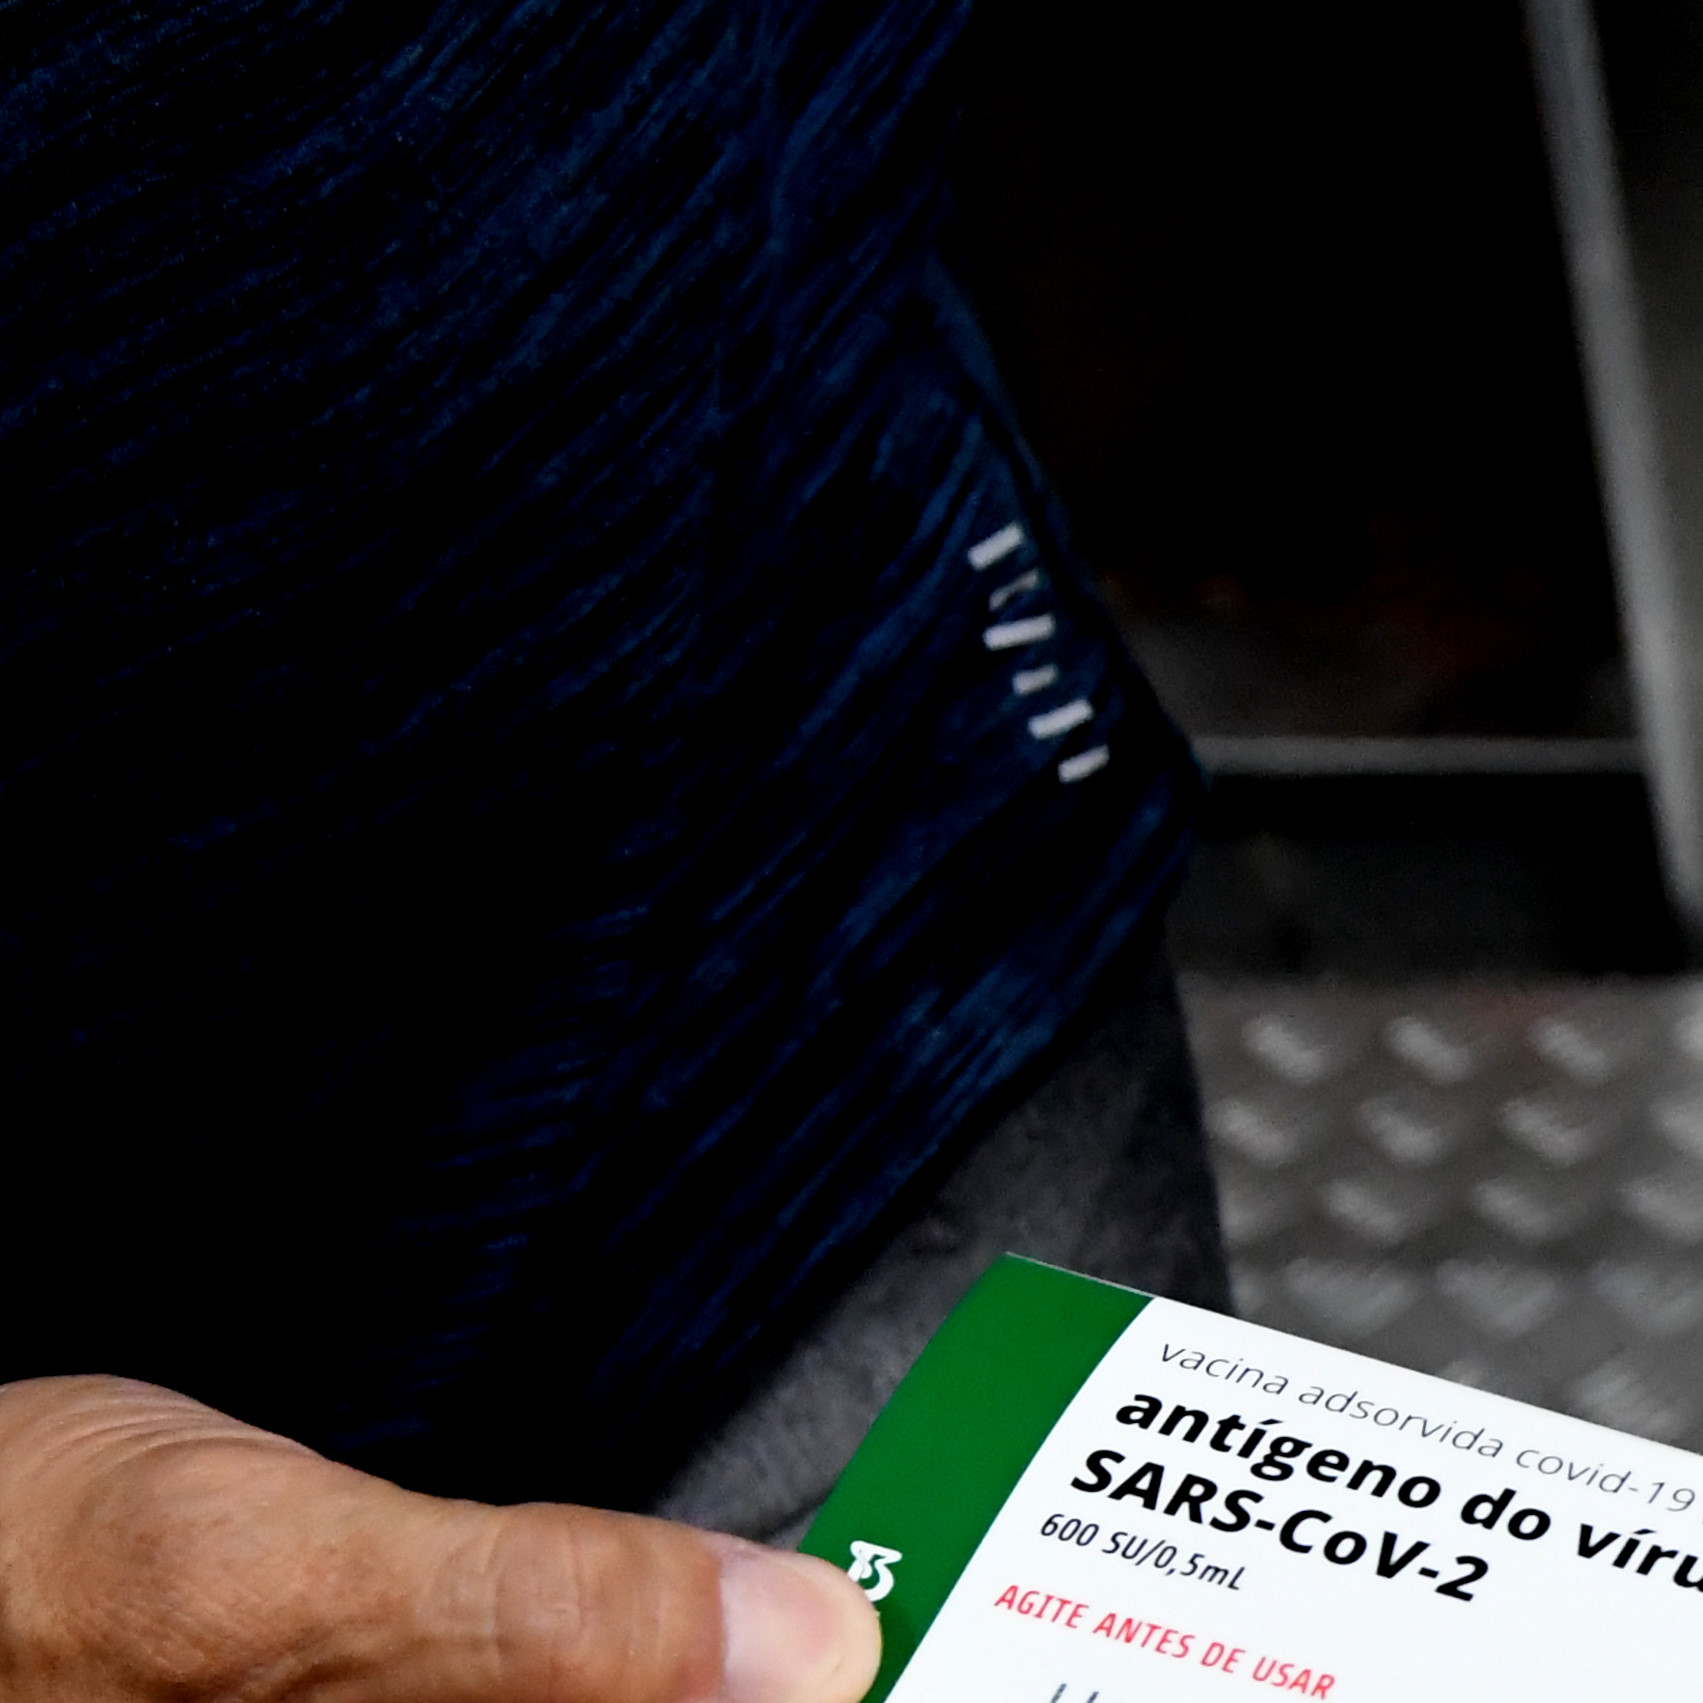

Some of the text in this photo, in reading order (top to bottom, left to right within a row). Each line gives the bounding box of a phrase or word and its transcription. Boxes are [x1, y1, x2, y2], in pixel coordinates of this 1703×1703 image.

[1115, 1393, 1442, 1509] antígeno
[1460, 1487, 1551, 1541] do
[1161, 1343, 1289, 1396] vacina
[1297, 1385, 1504, 1459] adsorvida
[1515, 1449, 1696, 1513] covid-19
[1040, 1513, 1246, 1591] 600 SU/0,5mL
[1070, 1449, 1489, 1602] SARS-CoV-2
[993, 1584, 1336, 1701] AGITE ANTES DE USAR
